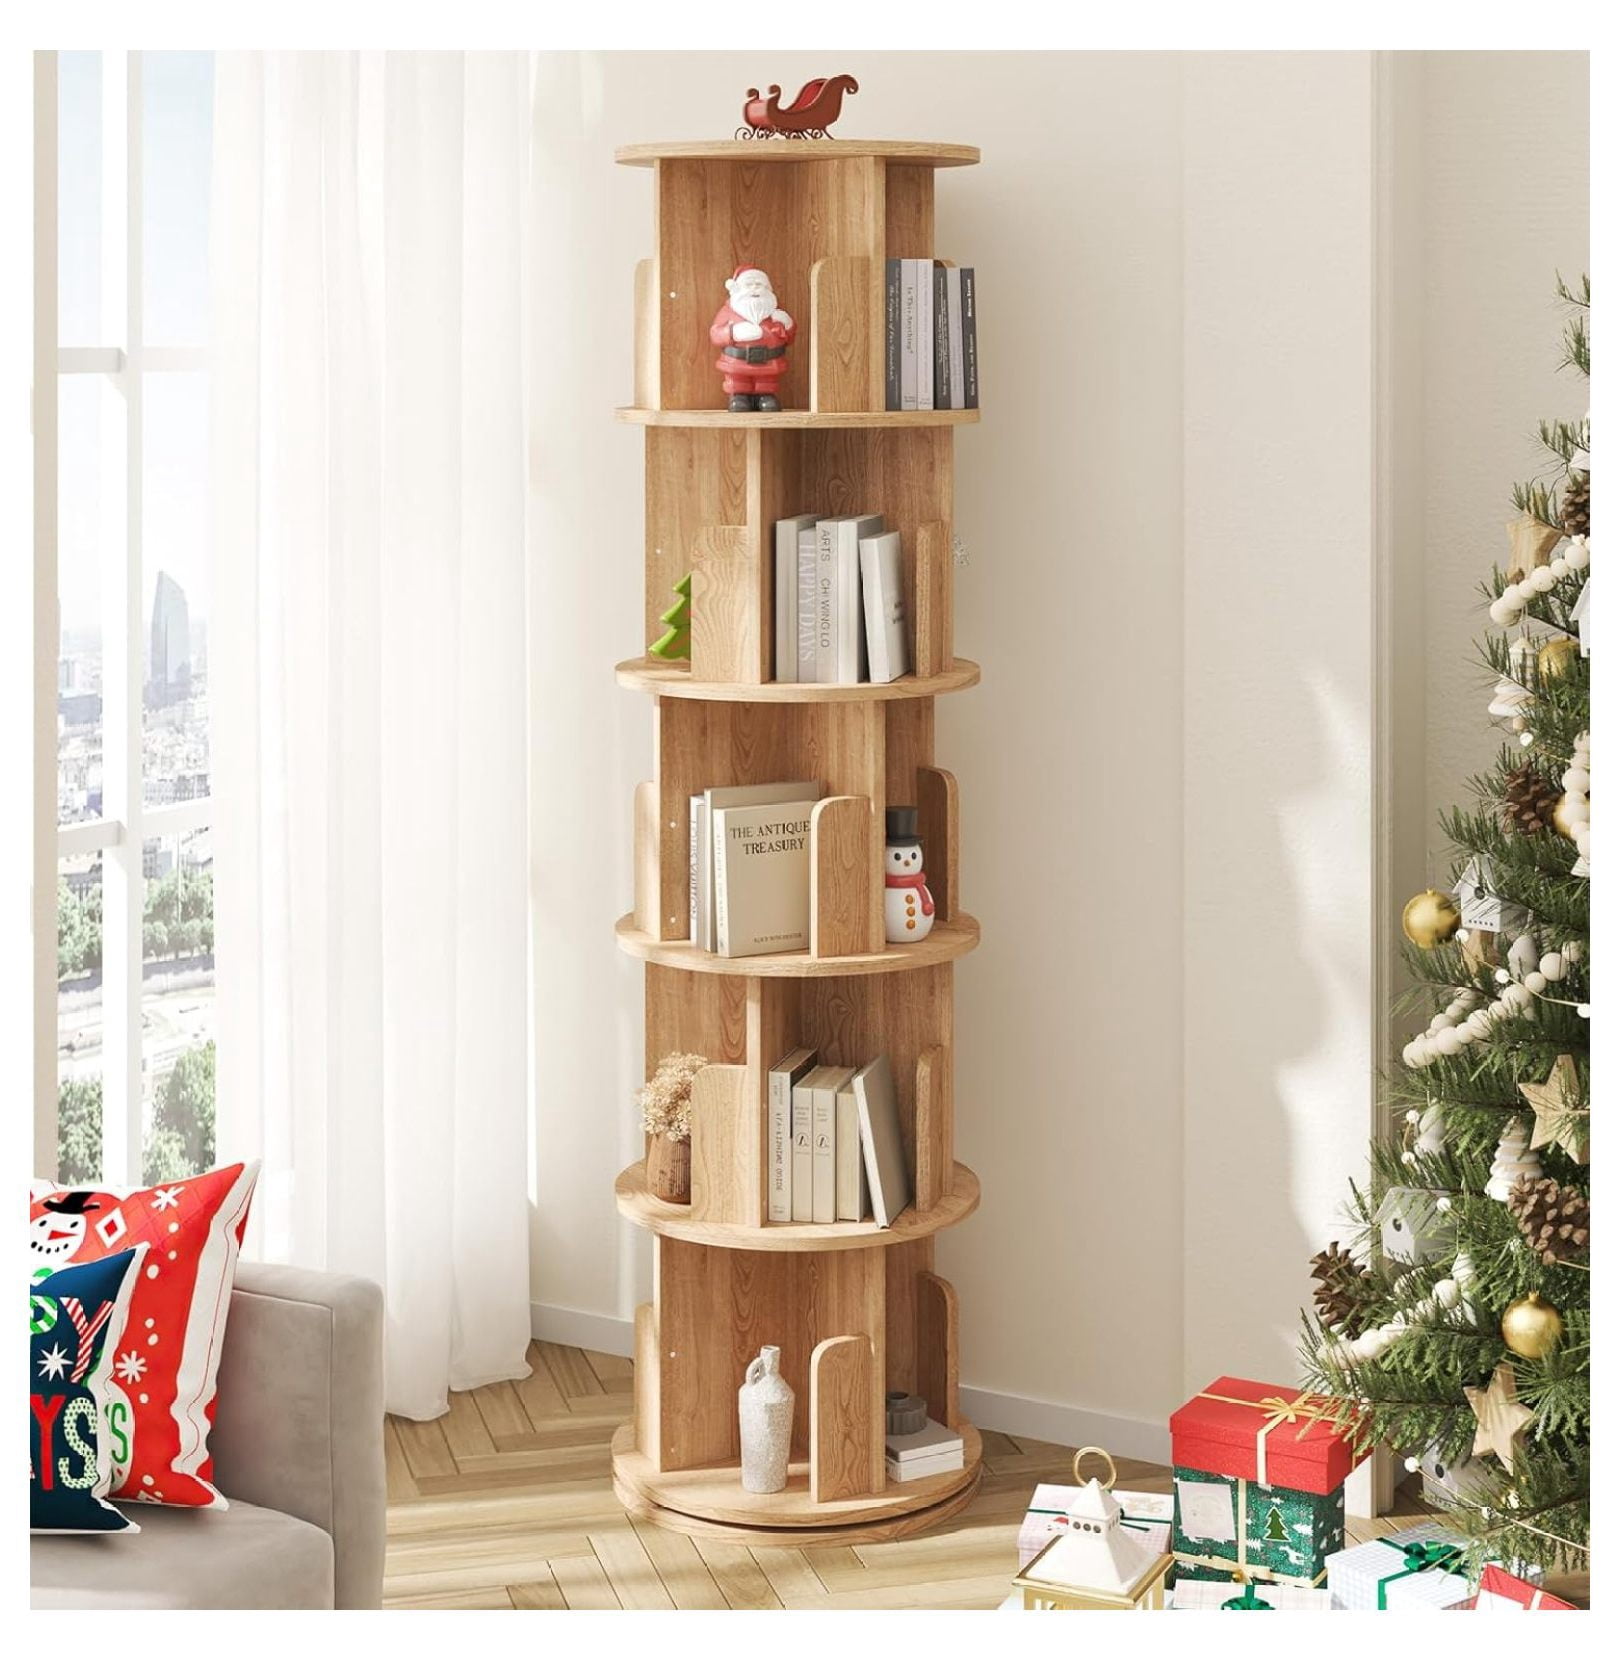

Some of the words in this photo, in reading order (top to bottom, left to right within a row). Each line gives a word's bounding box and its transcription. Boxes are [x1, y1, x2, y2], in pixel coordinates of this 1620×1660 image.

[821, 530, 831, 562] ARTS
[799, 544, 815, 608] HAPPY
[799, 613, 815, 662] DAYS
[730, 826, 753, 840] THE
[756, 820, 811, 837] ANTIQUE
[742, 838, 805, 855] TREASURY
[30, 1394, 98, 1490] YS
